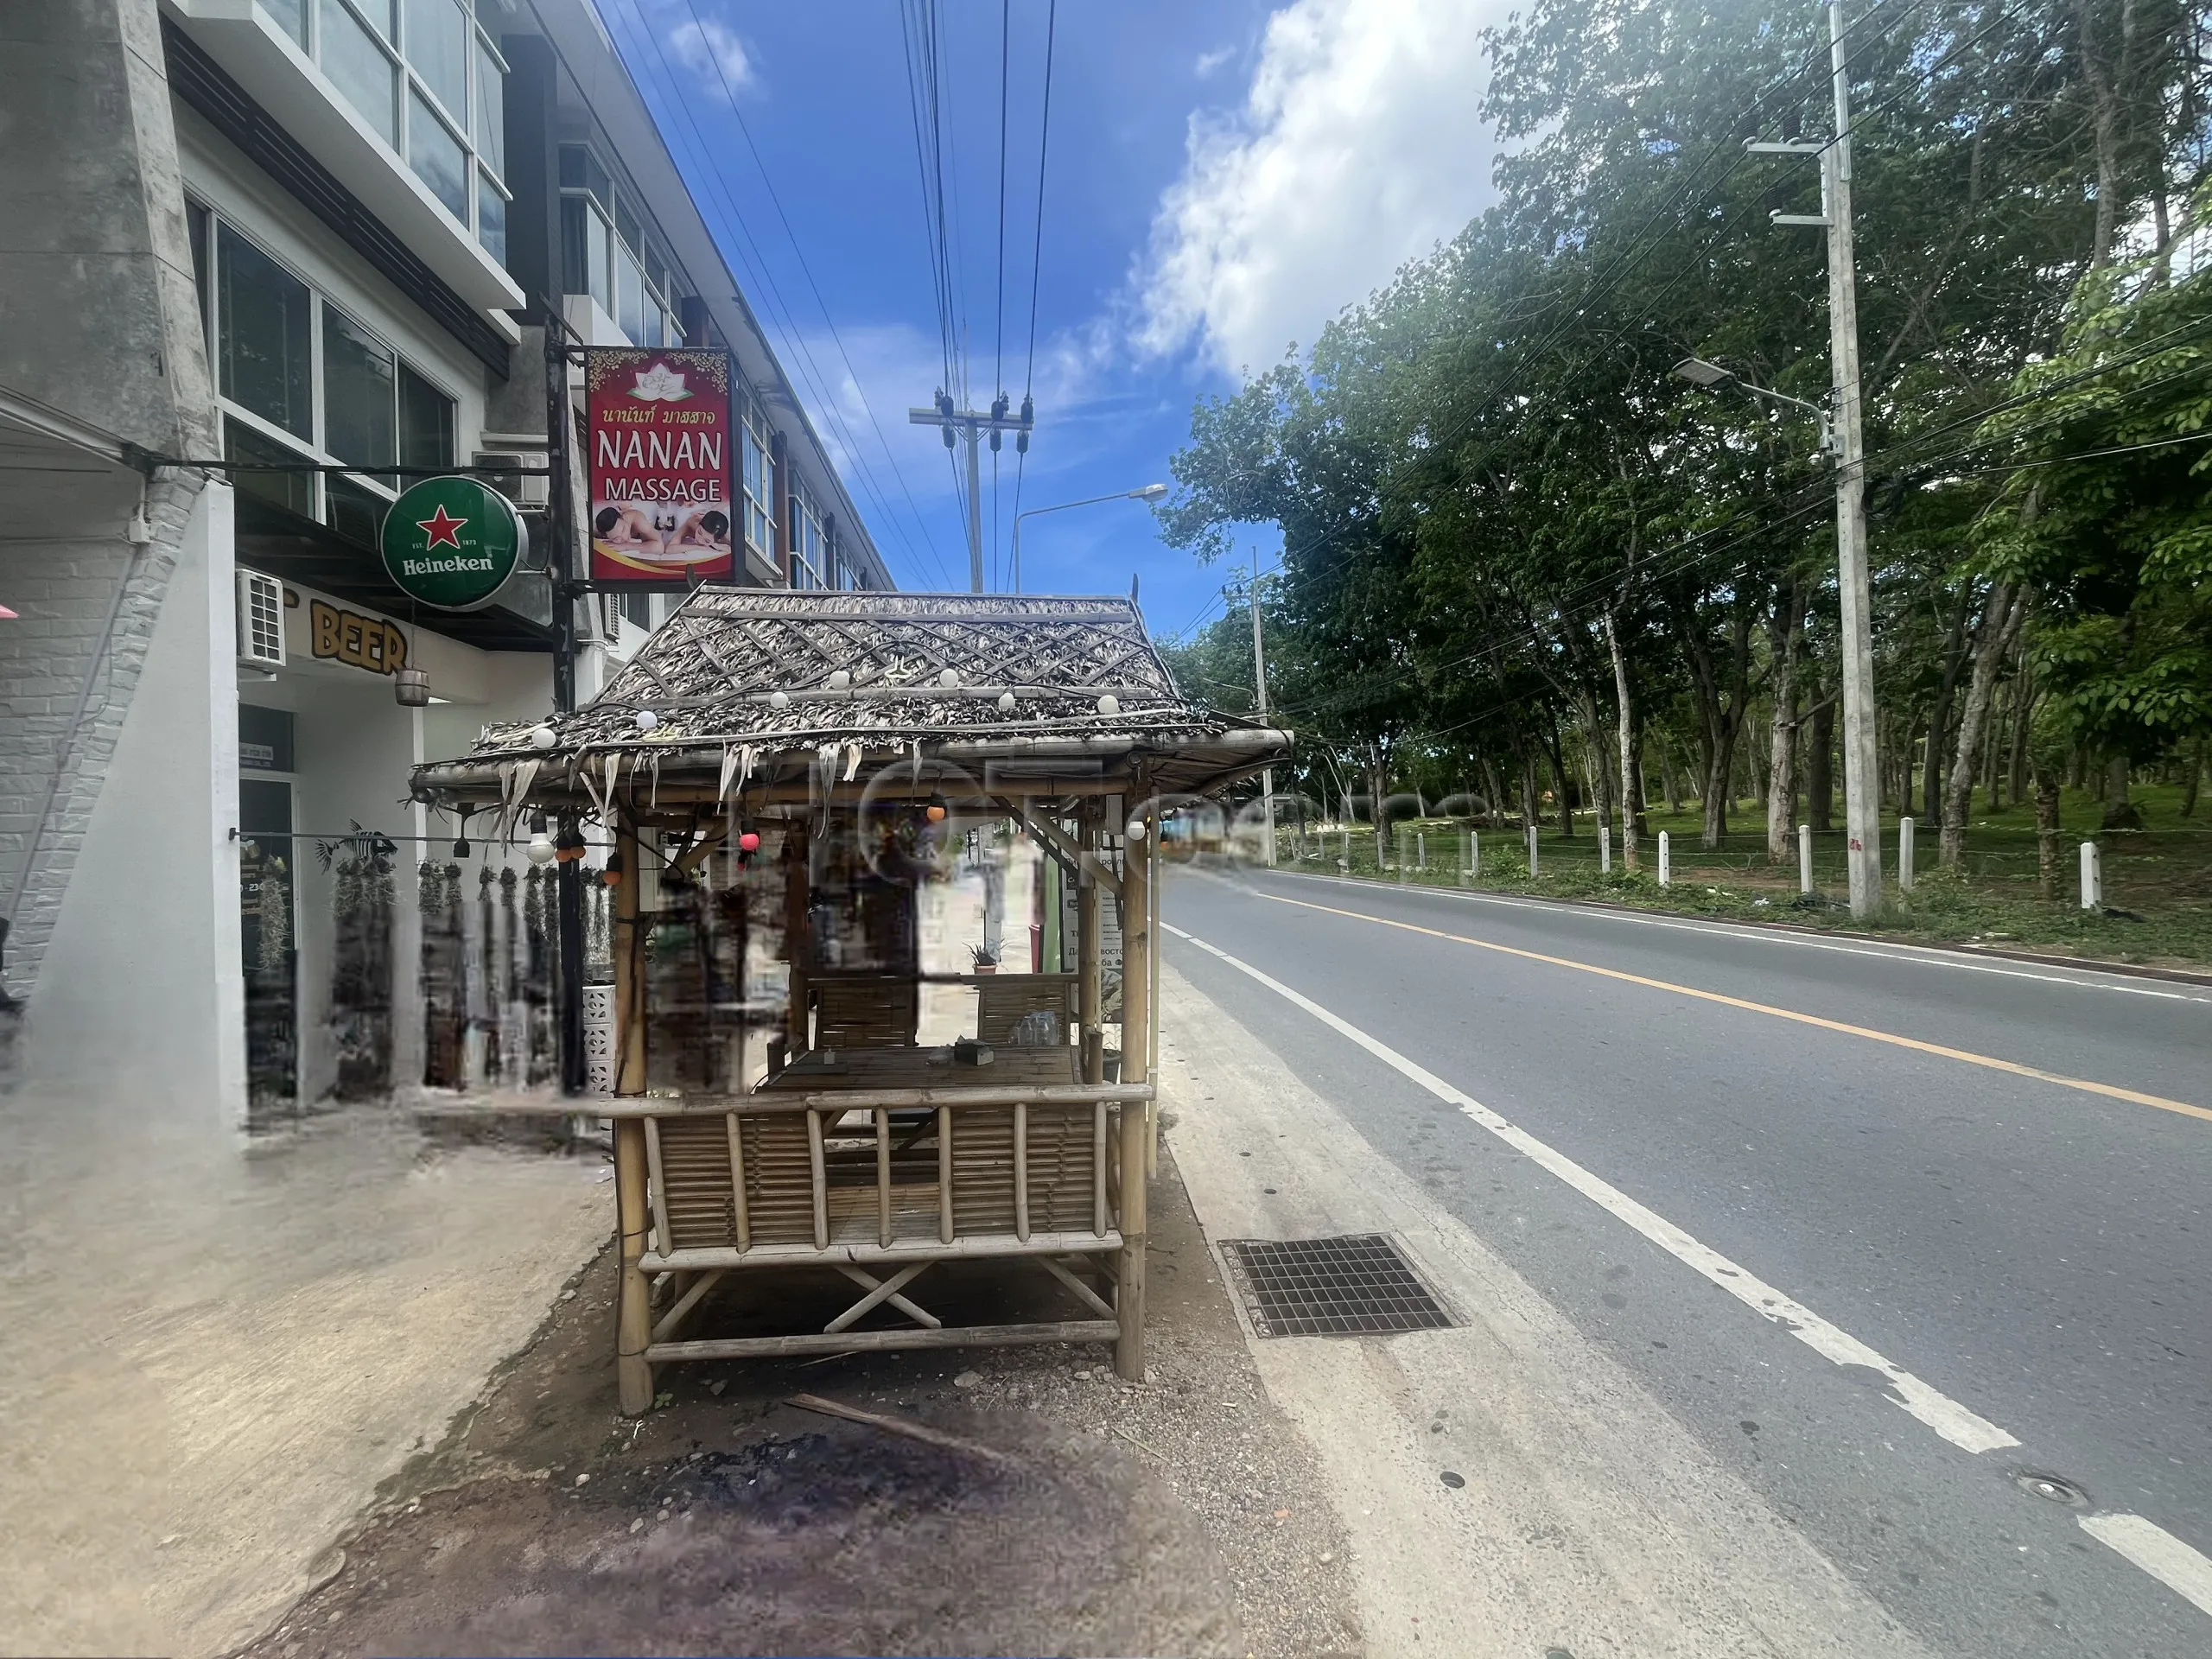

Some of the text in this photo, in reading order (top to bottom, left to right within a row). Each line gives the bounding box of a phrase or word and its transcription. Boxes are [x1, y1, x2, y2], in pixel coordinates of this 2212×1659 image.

[602, 404, 657, 423] นานันท์
[597, 429, 721, 470] NANAN
[605, 477, 721, 501] MASSAGE
[402, 555, 494, 576] Heineken
[310, 598, 408, 676] BEER
